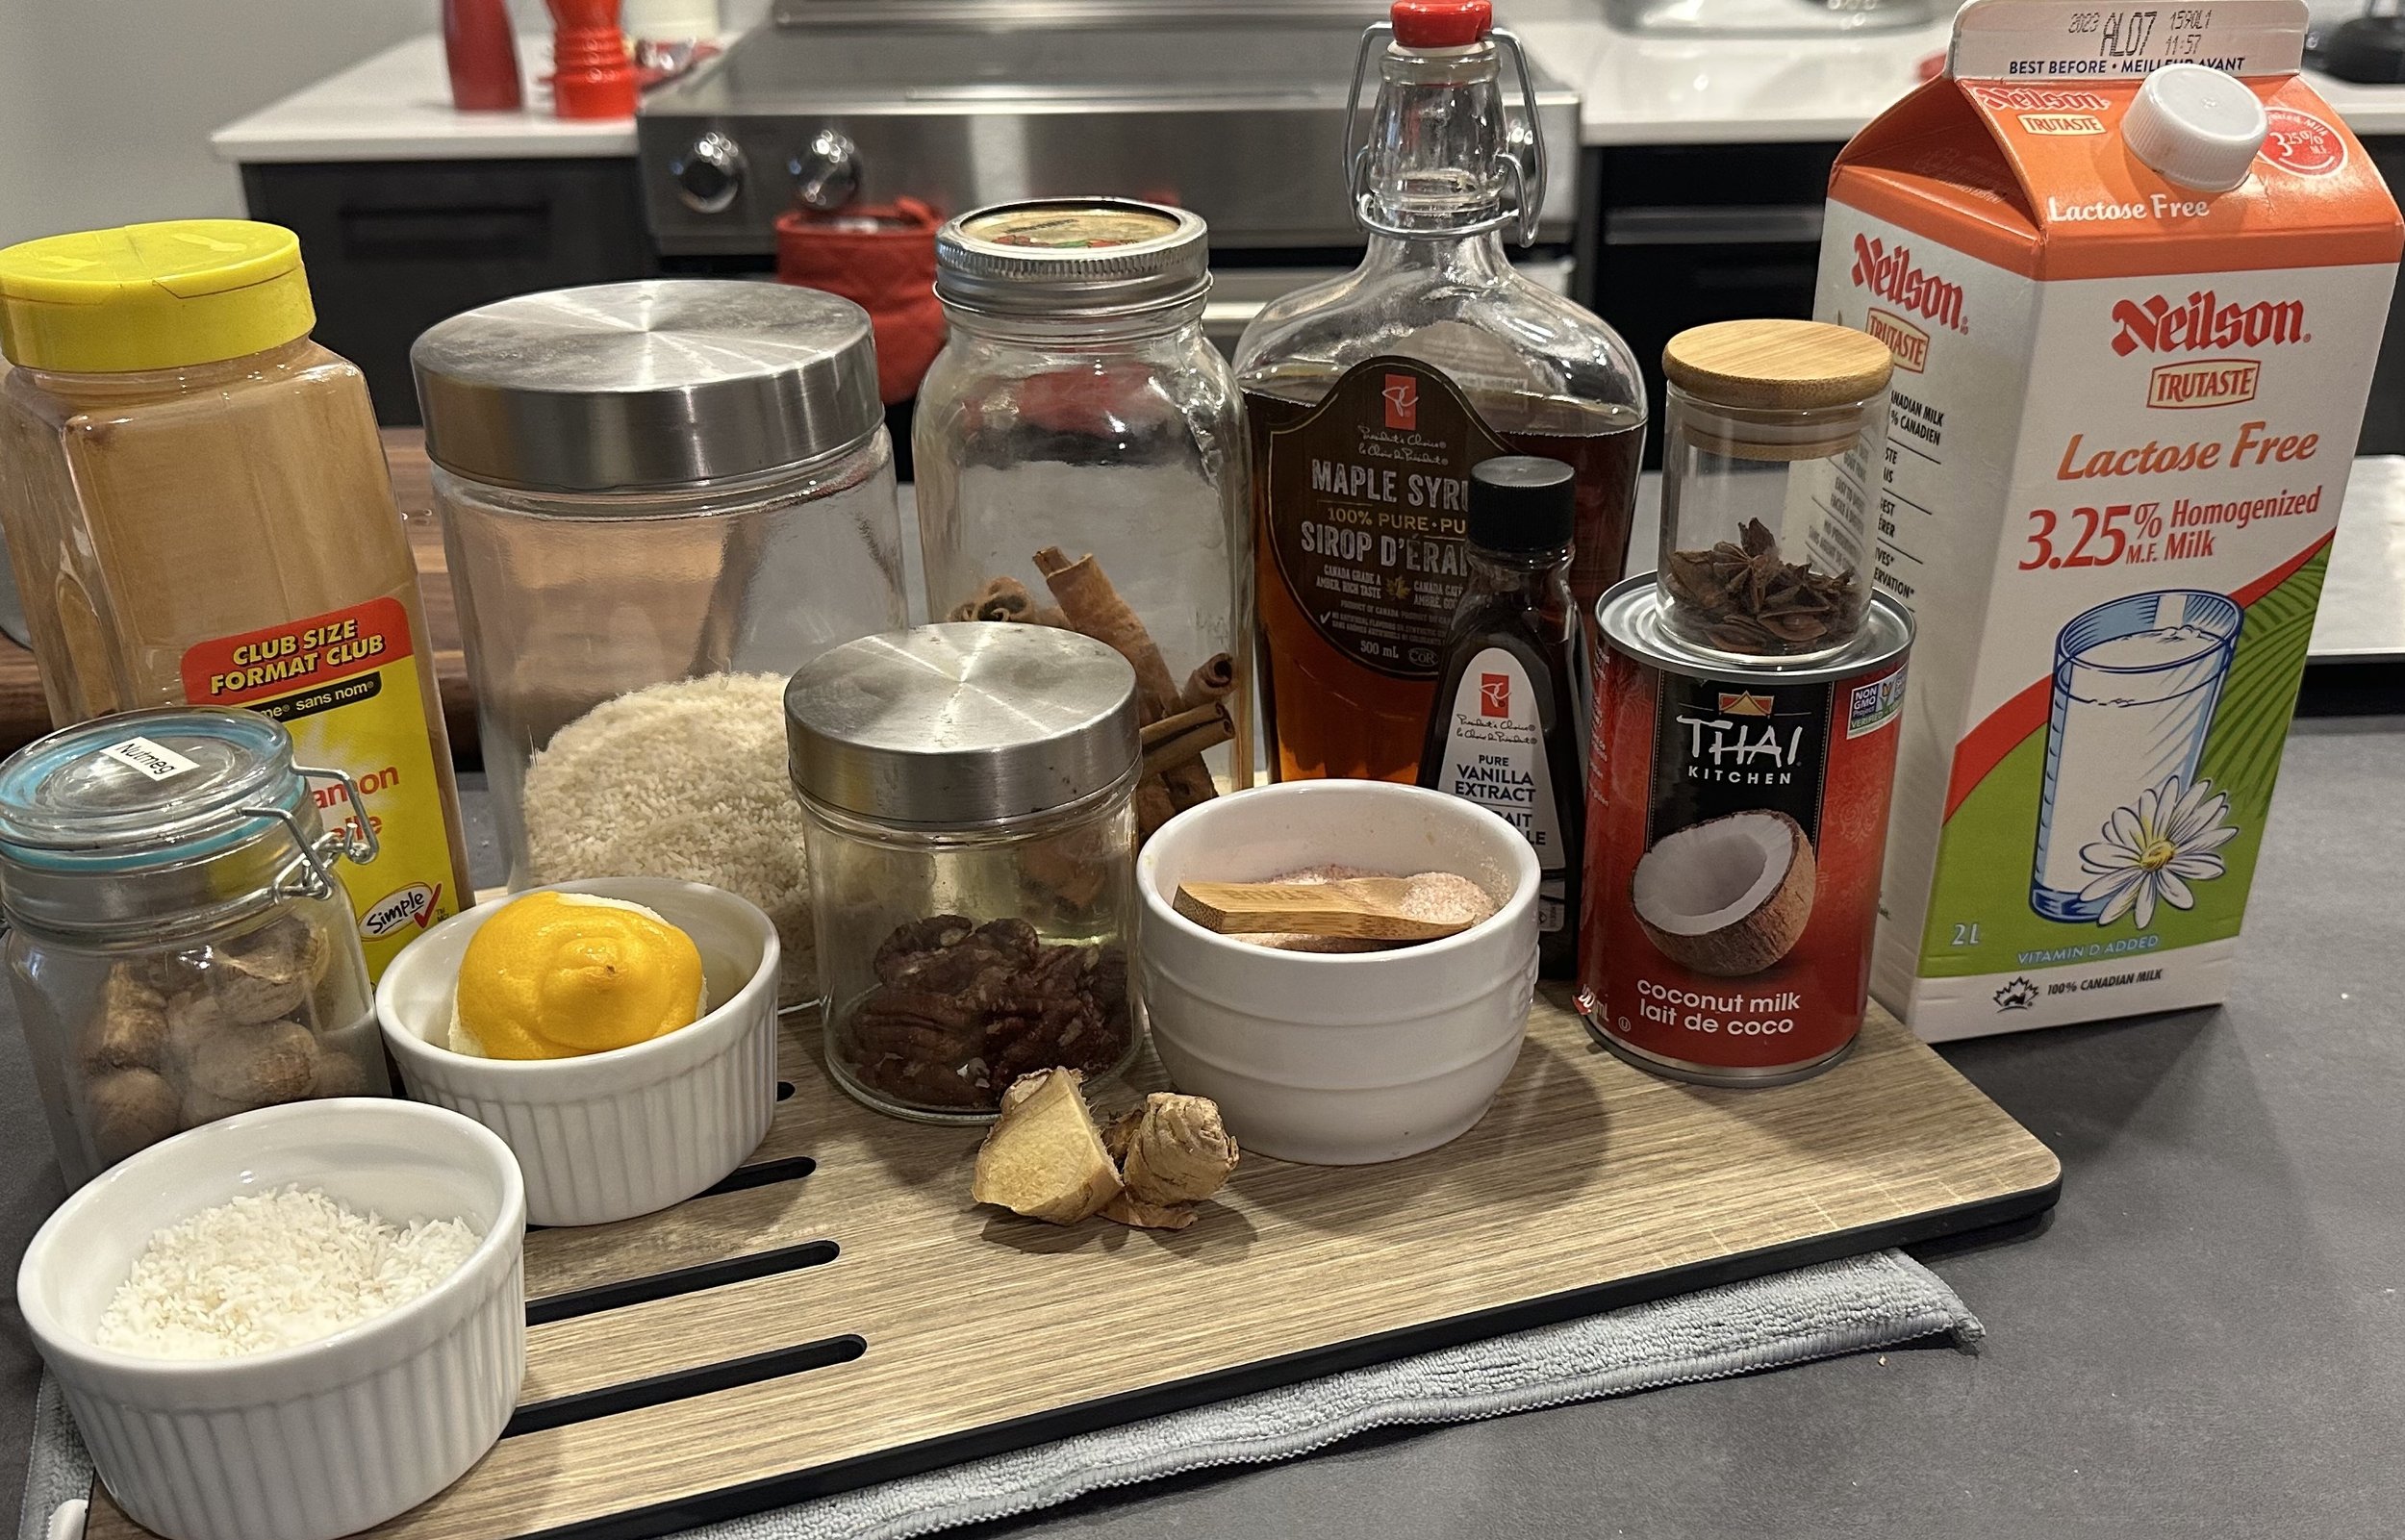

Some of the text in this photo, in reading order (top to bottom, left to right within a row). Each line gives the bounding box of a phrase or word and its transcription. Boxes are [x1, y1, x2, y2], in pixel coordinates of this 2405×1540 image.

[2009, 61, 2044, 74] BEST
[2049, 60, 2107, 74] BEFORE
[1976, 88, 2106, 112] Neilson
[2023, 116, 2104, 133] TRUTASTE
[2047, 193, 2210, 223] Lactose Free
[1852, 233, 1963, 331] Neilson
[2111, 290, 2304, 357] Neilson
[2157, 367, 2256, 403] TRUTASTE
[1922, 401, 1944, 427] MILK
[1900, 416, 1941, 446] CANADIEN
[1885, 447, 1898, 466] STE
[2057, 420, 2319, 481] Lactose Free
[1312, 459, 1469, 513] MAPLE SYR
[1328, 507, 1466, 534] 100% PURE PU
[2170, 485, 2321, 529] Homogenized
[1301, 520, 1373, 563] SIROP
[2164, 529, 2215, 561] Milk
[1360, 585, 1381, 599] TASTE
[1413, 580, 1443, 594] CANADA
[233, 619, 358, 667] CLUB SIZE
[1360, 640, 1399, 659] 500 mL
[211, 634, 385, 695] FORMAT CLUB
[295, 692, 333, 712] sans
[335, 683, 368, 700] nom
[1854, 695, 1876, 710] GMO
[1855, 686, 1877, 701] NON
[1851, 712, 1884, 729] VERIFIED
[1676, 715, 1803, 769] THAI
[114, 741, 177, 776] Nutmeg
[1479, 754, 1509, 767] PURE
[1456, 764, 1534, 786] VANILLA
[1688, 766, 1791, 784] KITCHEN
[1455, 781, 1536, 803] EXTRACT
[367, 891, 425, 934] Simple
[2017, 935, 2160, 964] VITAMIN D ADDED
[1636, 979, 1801, 1013] coconut milk
[2047, 969, 2164, 997] 100% CANADIAN MILK
[1639, 998, 1794, 1035] lait de coco
